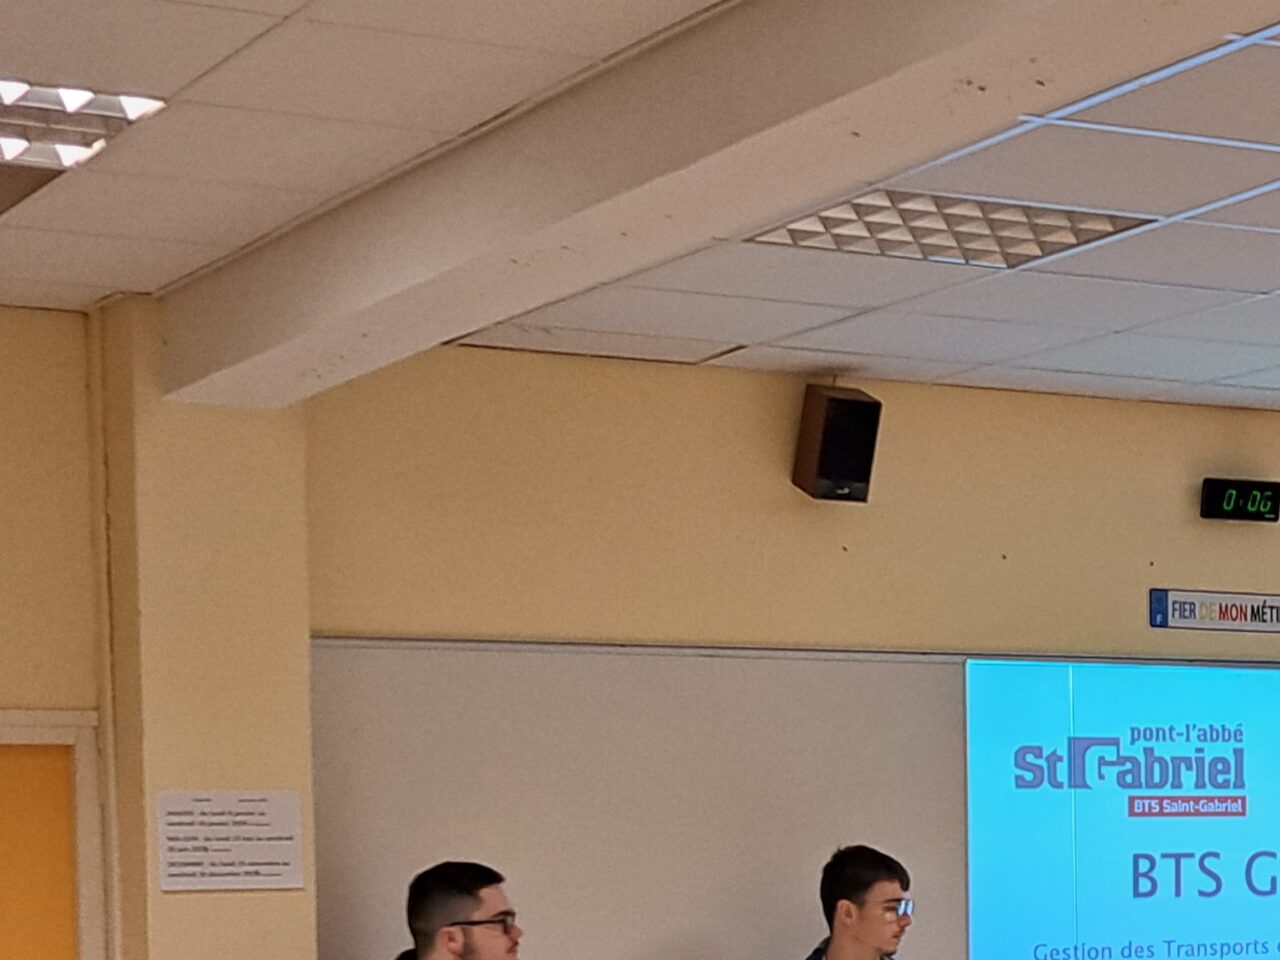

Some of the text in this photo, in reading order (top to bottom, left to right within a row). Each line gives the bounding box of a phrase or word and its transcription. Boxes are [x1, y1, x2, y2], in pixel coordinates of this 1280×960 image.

[1171, 600, 1197, 620] FIER
[1200, 602, 1216, 621] DE
[1218, 602, 1248, 622] MON
[1129, 723, 1244, 746] pont-l'abbé
[1134, 799, 1243, 814] BTS Saint-Gabriel
[1132, 851, 1223, 899] BTS
[1120, 940, 1155, 960] des
